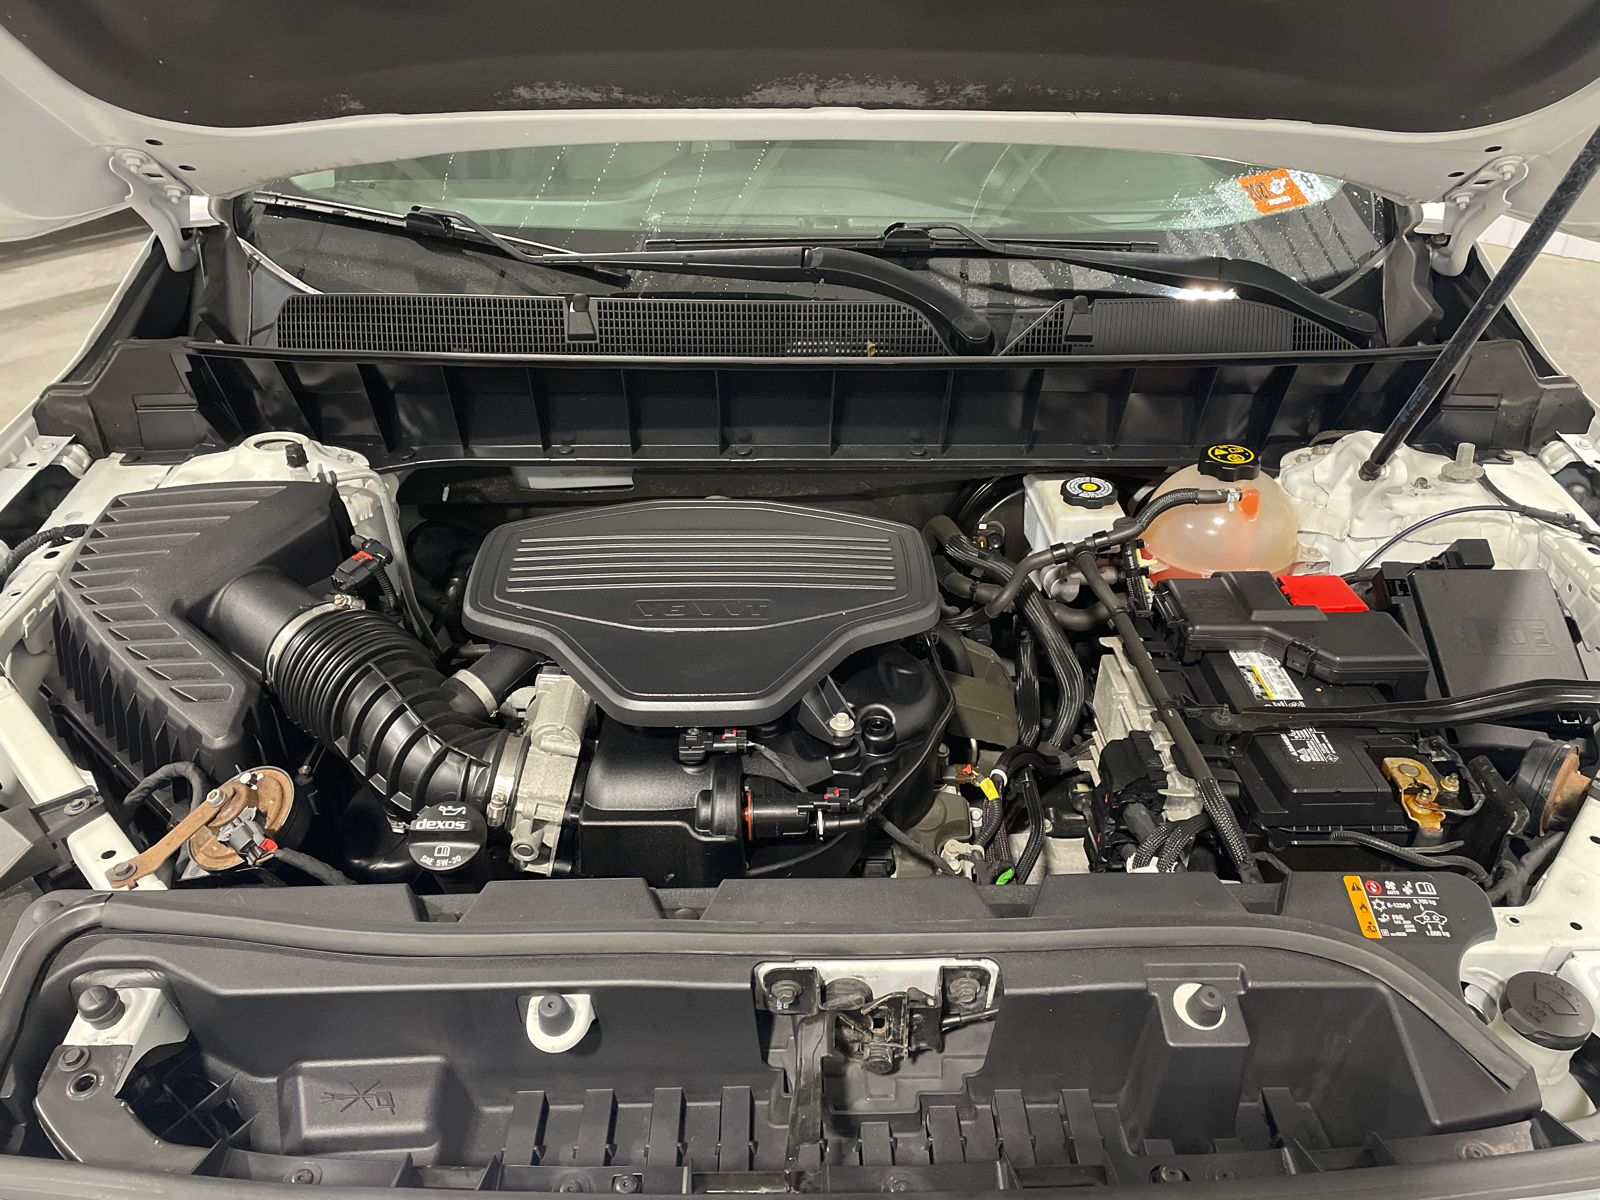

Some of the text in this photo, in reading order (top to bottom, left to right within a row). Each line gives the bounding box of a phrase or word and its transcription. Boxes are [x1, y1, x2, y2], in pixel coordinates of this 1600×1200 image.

[415, 818, 466, 830] dexos
[420, 855, 462, 867] SAE 5W-30
